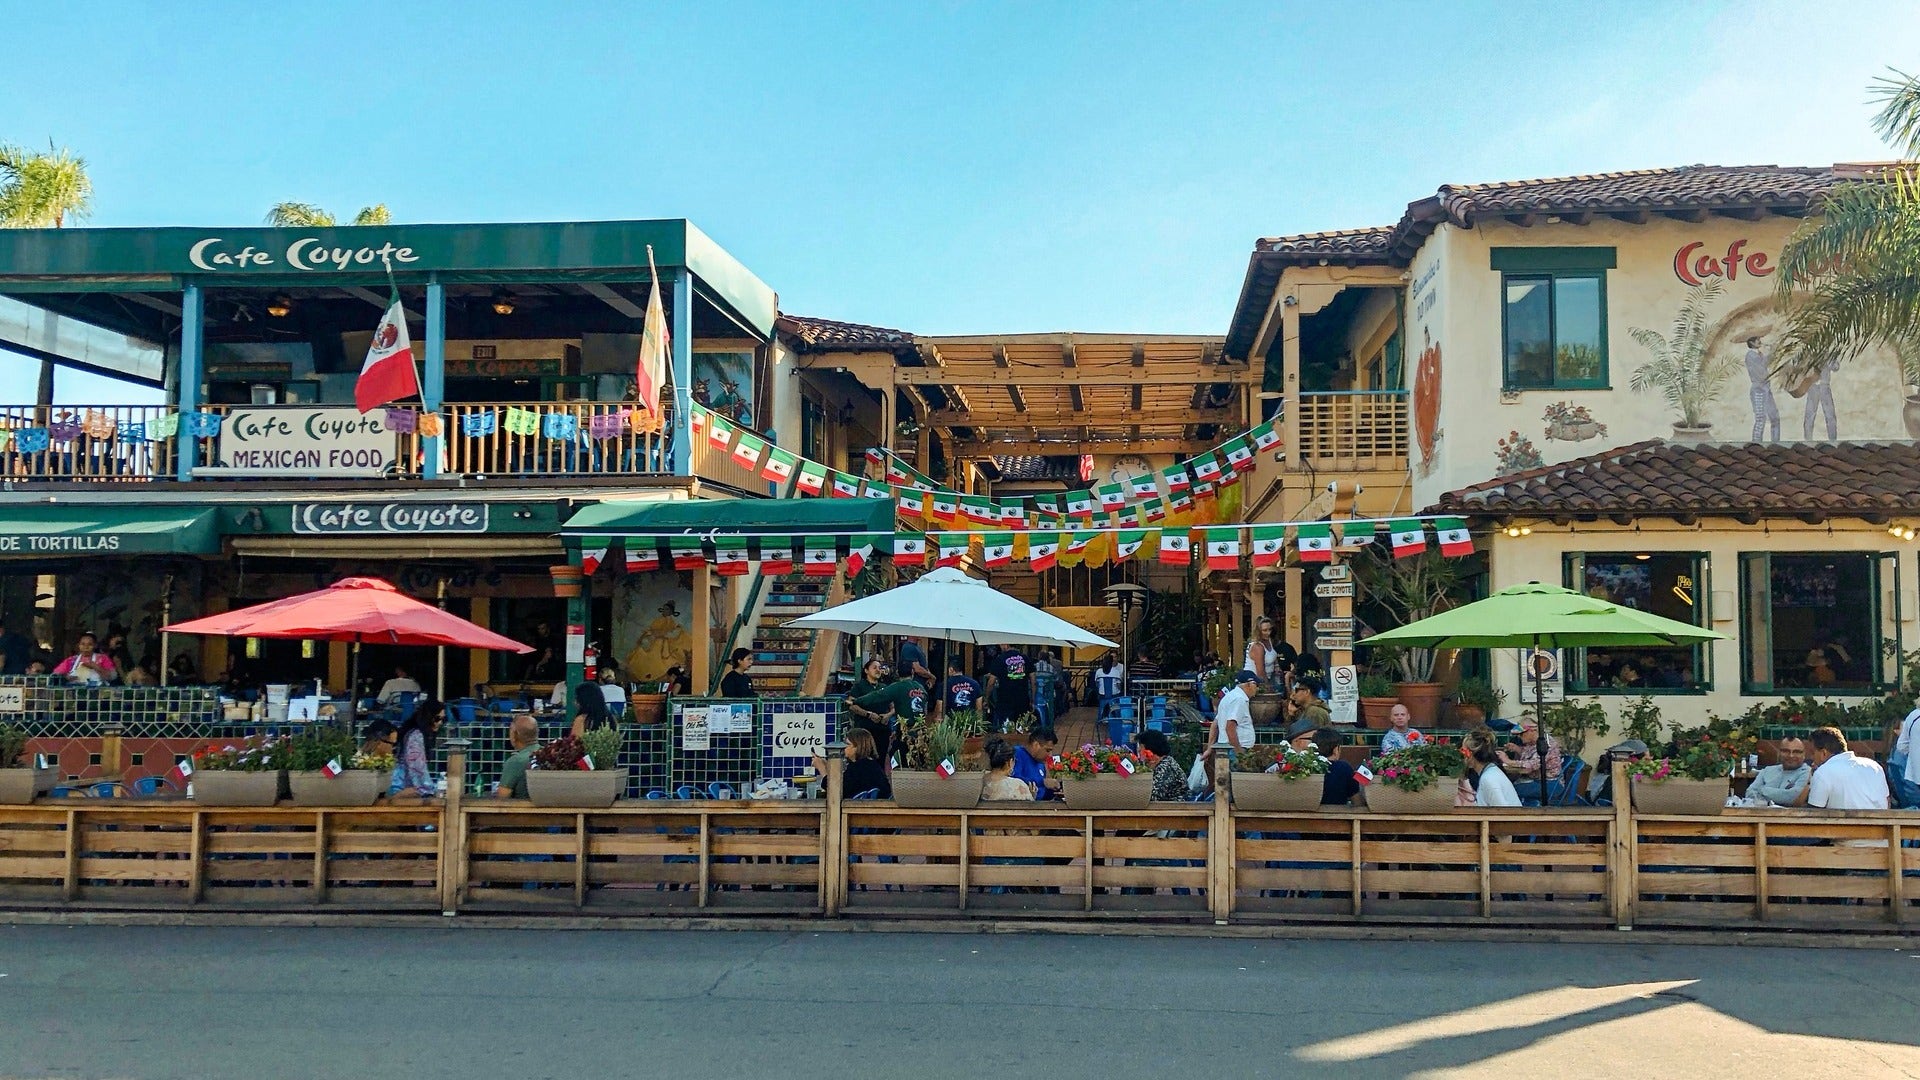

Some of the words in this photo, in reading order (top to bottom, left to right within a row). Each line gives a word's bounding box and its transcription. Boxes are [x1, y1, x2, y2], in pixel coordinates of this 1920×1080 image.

[189, 238, 274, 271] Cafe
[286, 238, 420, 272] Coyote
[1674, 239, 1775, 286] Cafe
[232, 413, 293, 441] Cafe
[304, 412, 384, 441] Coyote
[233, 450, 321, 468] MEXICAN
[329, 450, 383, 468] FOOD
[303, 504, 373, 532] Cafe
[380, 504, 480, 532] Coyote
[0, 536, 20, 551] DE
[28, 536, 120, 550] TORTILLAS
[1329, 568, 1340, 576] ATM
[1317, 586, 1330, 595] CAFE
[1332, 585, 1352, 594] COYOTE
[787, 719, 815, 730] cafe
[775, 731, 823, 749] Coyote
